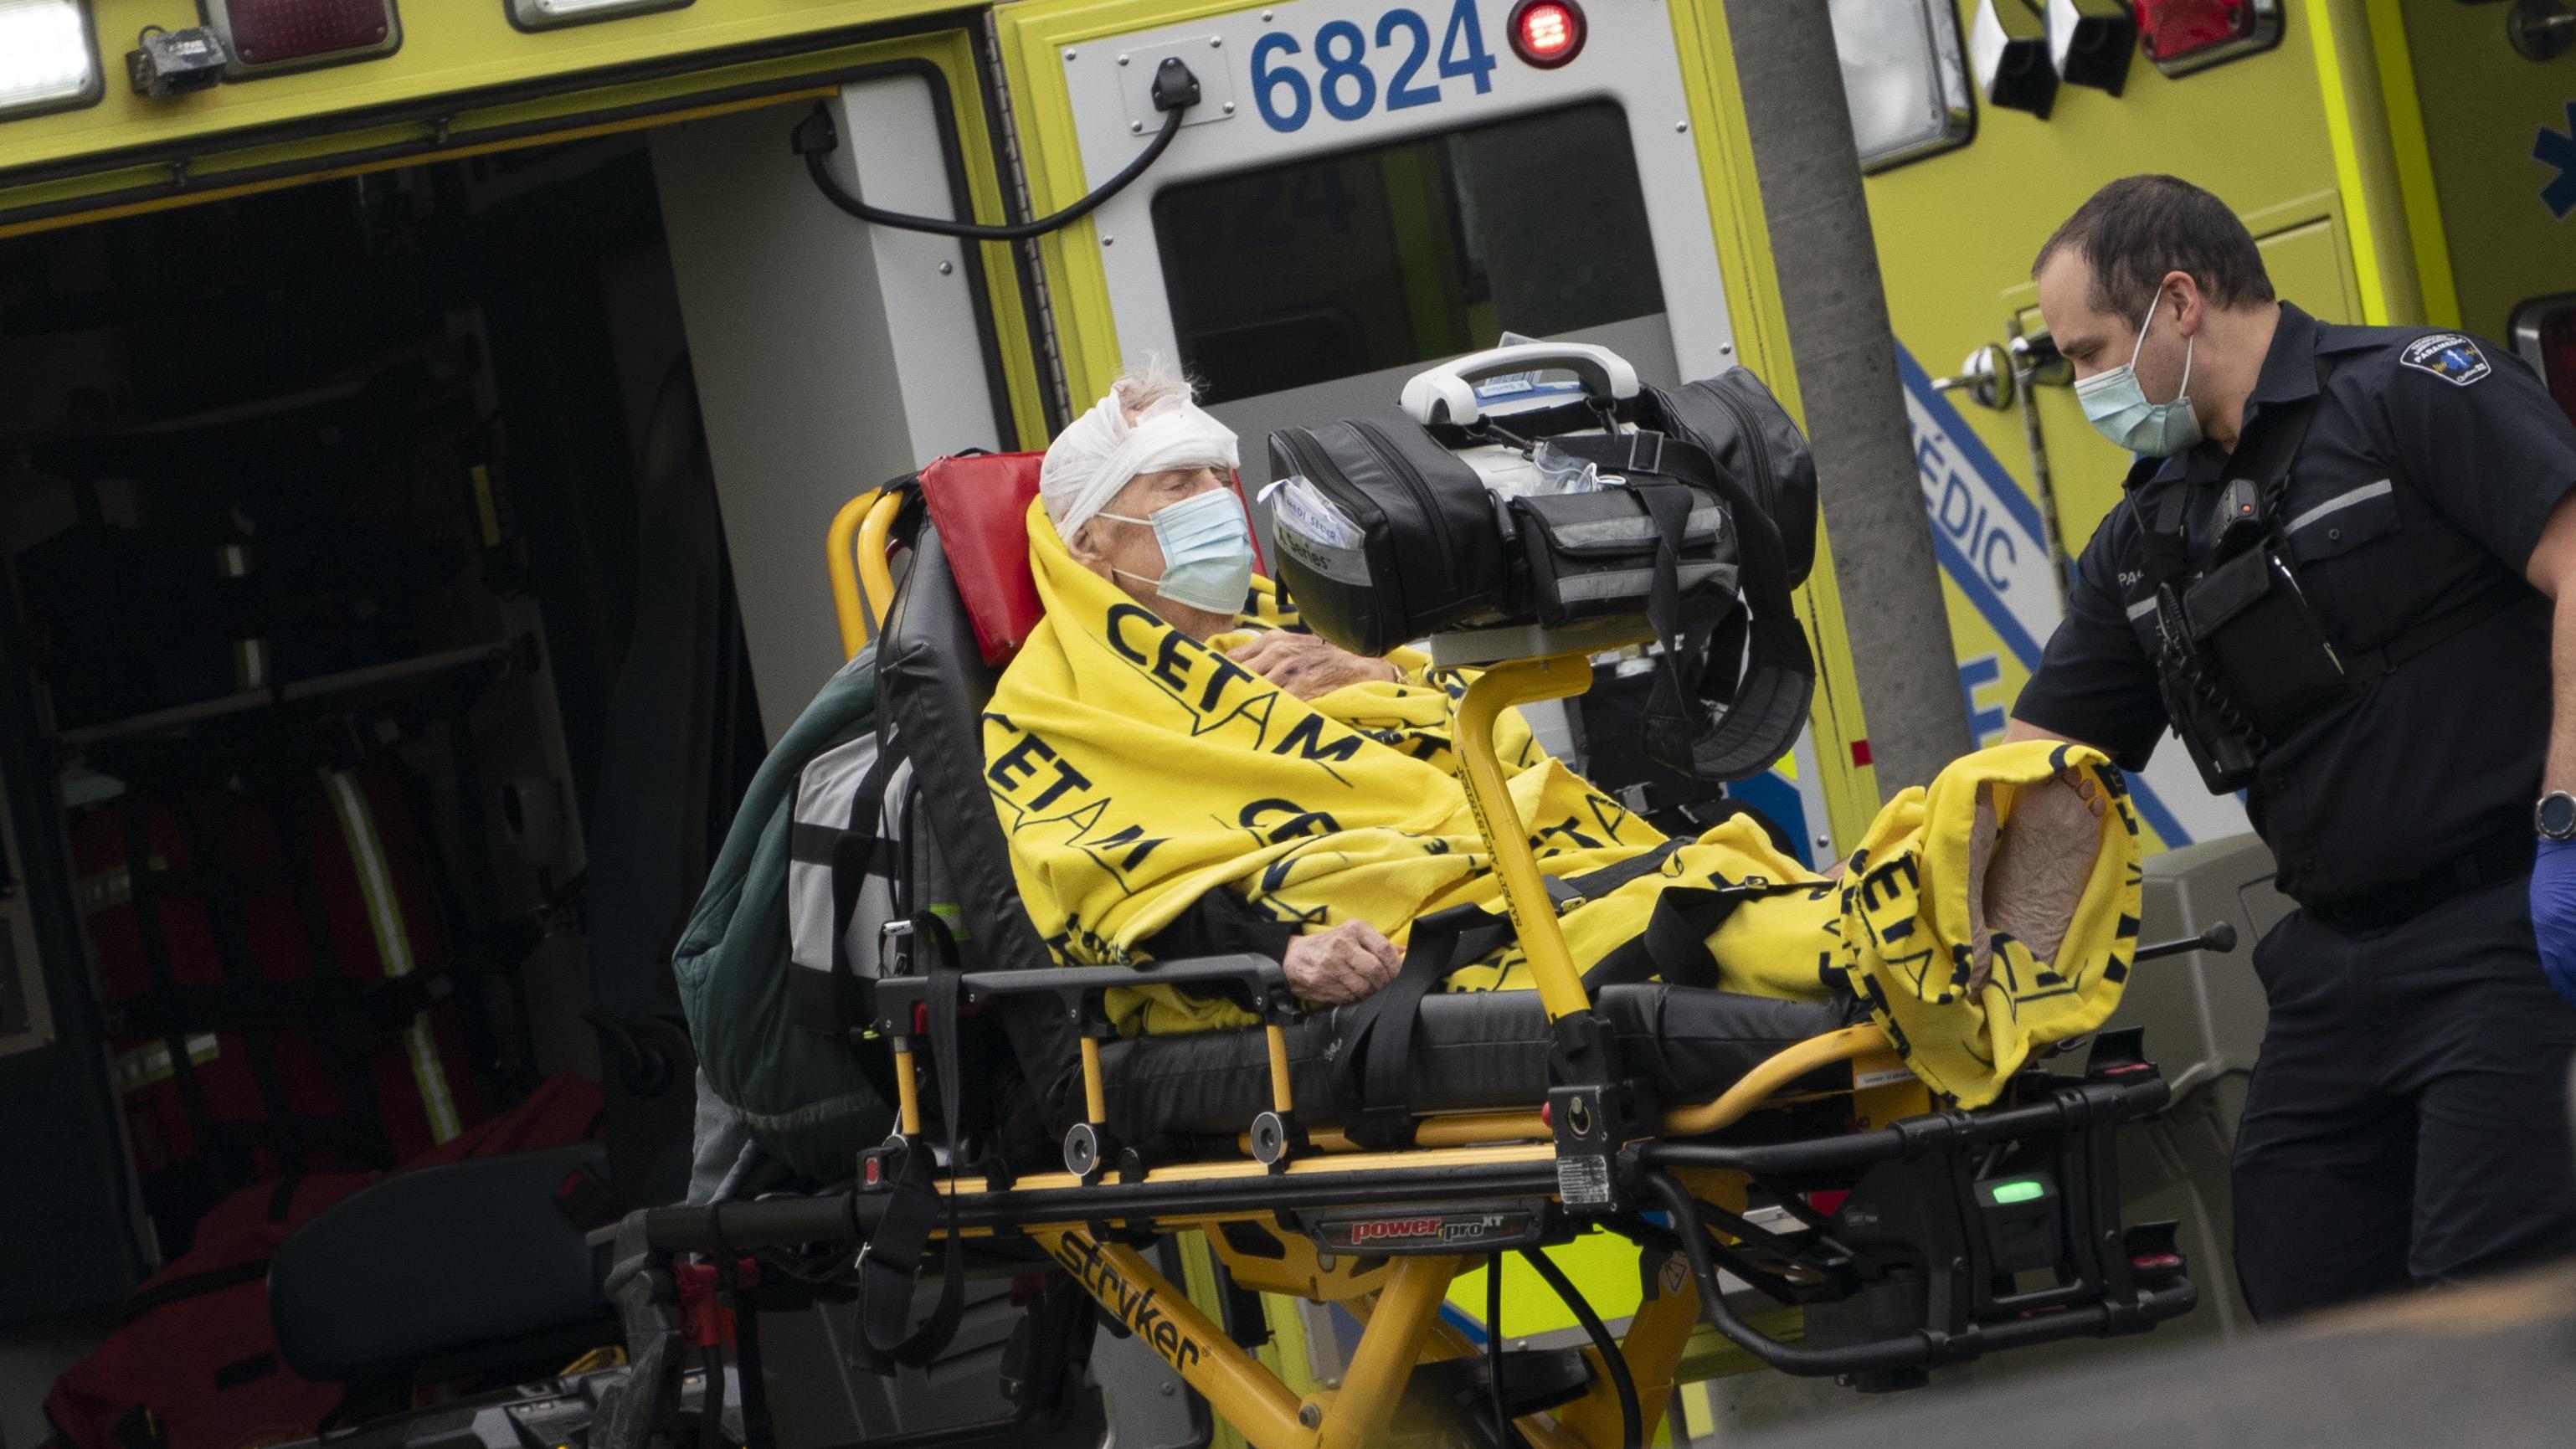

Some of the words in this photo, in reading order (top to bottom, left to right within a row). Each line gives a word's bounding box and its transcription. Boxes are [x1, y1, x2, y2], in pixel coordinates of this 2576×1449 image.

[1251, 0, 1496, 132] 6824
[1914, 427, 2017, 593] ÉDIC
[1106, 603, 1364, 762] CETAM
